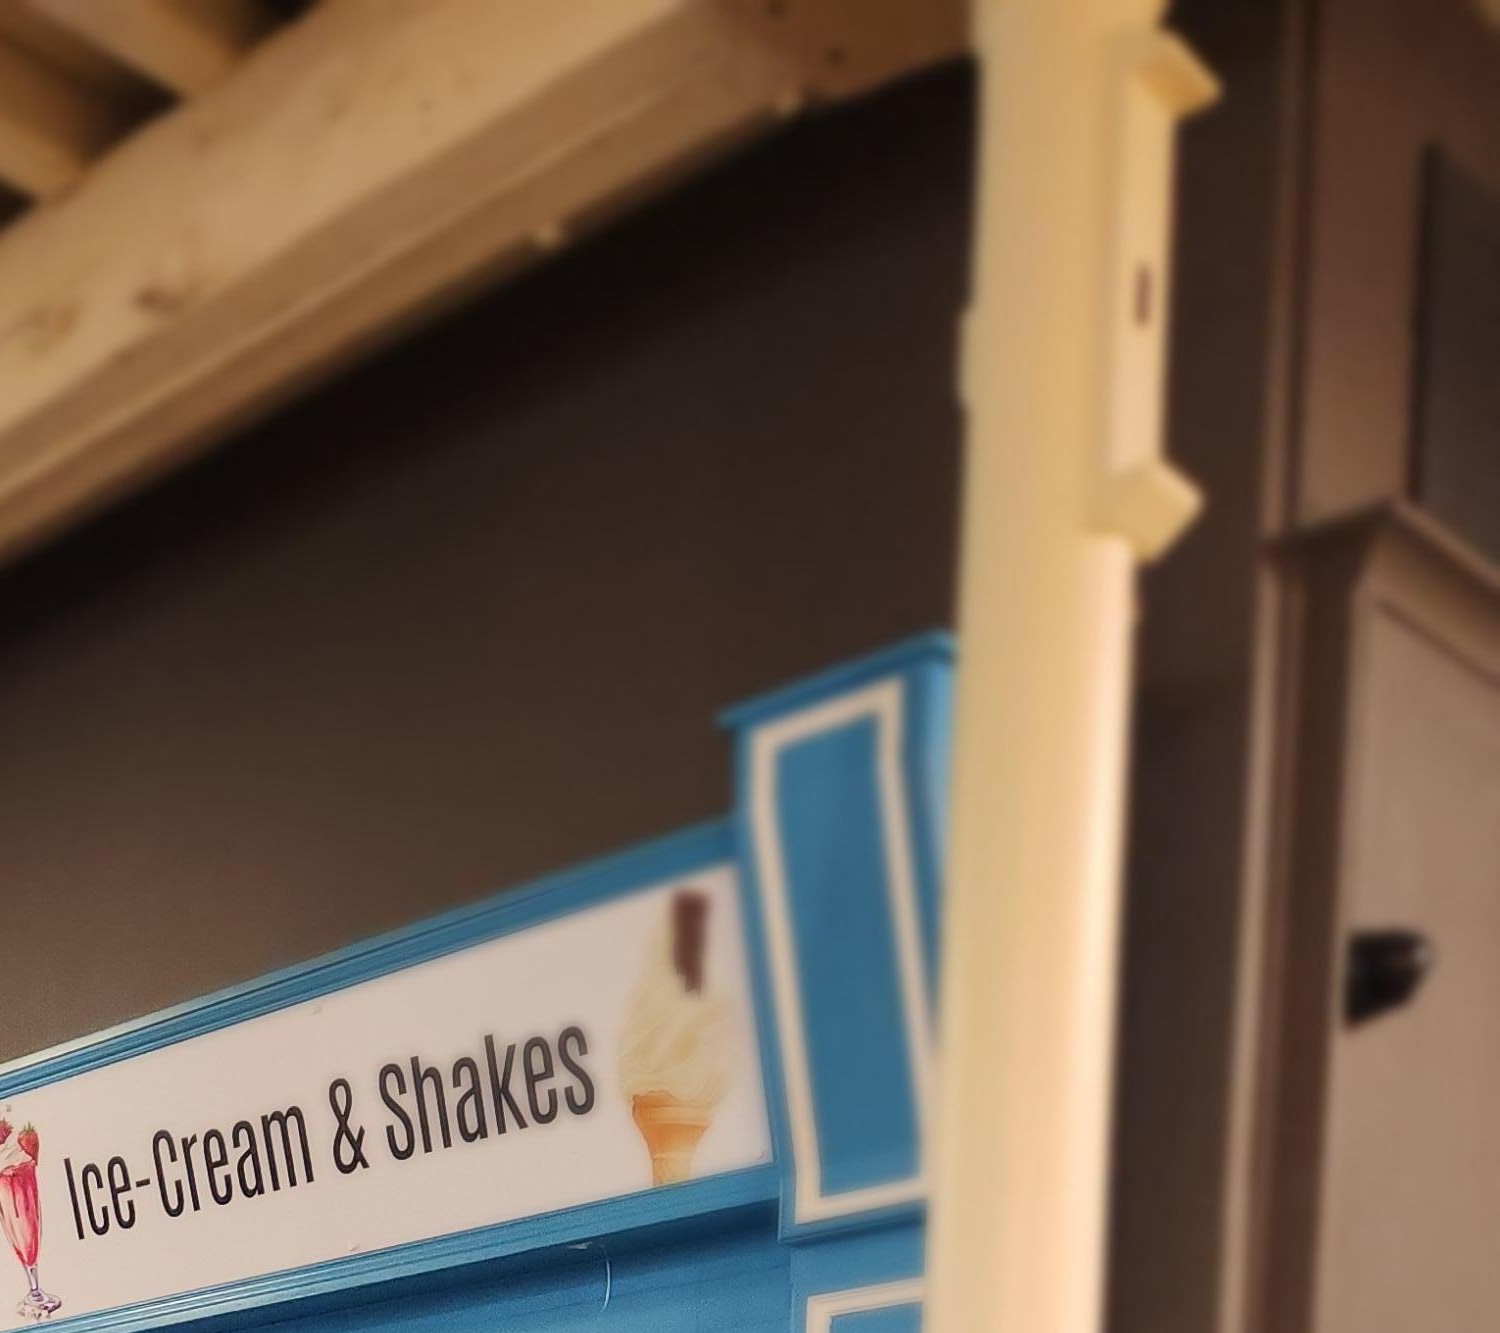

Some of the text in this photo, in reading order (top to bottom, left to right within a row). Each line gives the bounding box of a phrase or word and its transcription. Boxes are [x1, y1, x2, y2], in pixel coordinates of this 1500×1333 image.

[64, 1025, 596, 1241] Ice-Cream & Shakes
